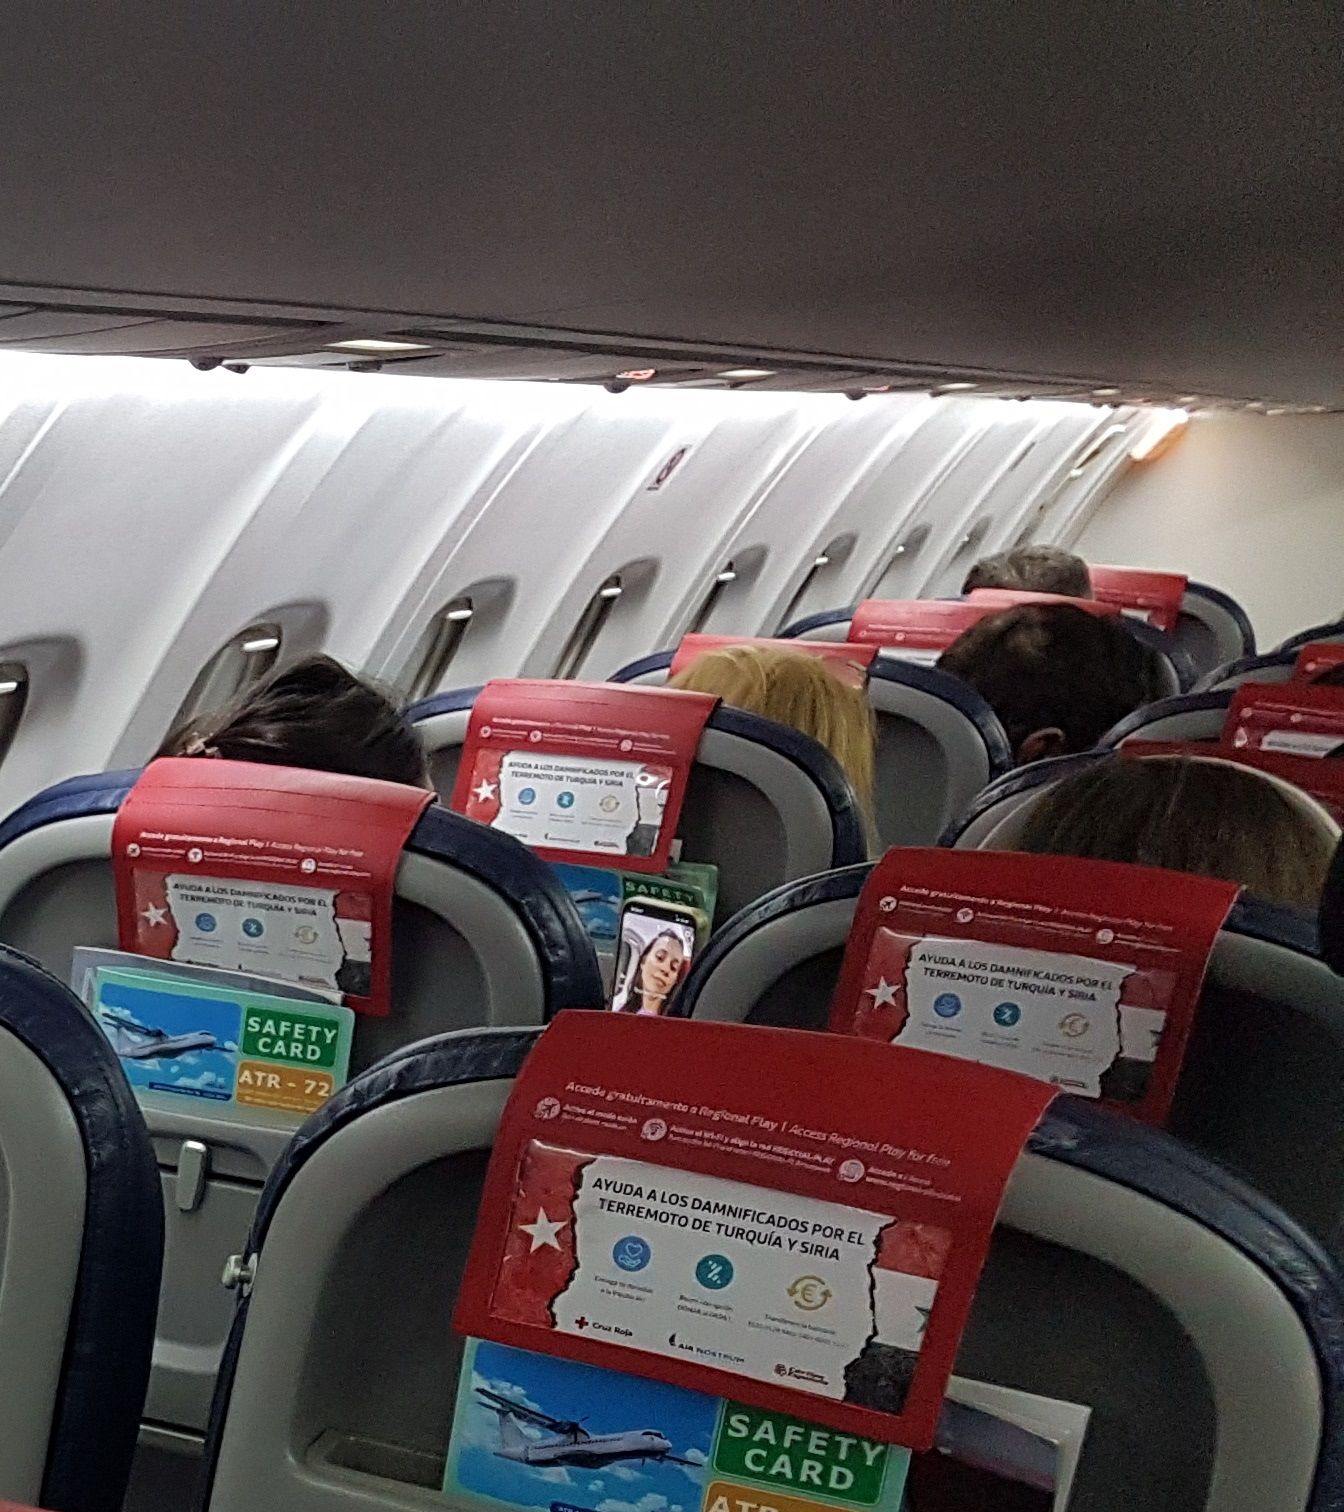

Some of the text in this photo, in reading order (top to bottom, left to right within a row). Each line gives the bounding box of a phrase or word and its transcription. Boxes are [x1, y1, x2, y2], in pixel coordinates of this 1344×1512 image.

[625, 881, 693, 901] SAFETY
[918, 952, 956, 966] AYUDA
[958, 959, 965, 967] A
[967, 960, 988, 971] LOS
[1075, 976, 1098, 988] POR
[247, 1016, 337, 1044] SAFETY
[258, 1037, 321, 1060] CARD
[238, 1069, 281, 1089] ATR
[304, 1080, 329, 1097] 72
[565, 1080, 606, 1097] Accede
[698, 1105, 749, 1127] Regional
[750, 1115, 778, 1132] Play
[788, 1123, 827, 1141] Access
[827, 1132, 879, 1154] Regional
[878, 1142, 906, 1160] Play
[907, 1149, 926, 1161] for
[592, 1176, 866, 1246] AYUDA A LOS DAMNIFICADOS POR EL
[598, 1197, 840, 1260] TERREMOTO DE TURQUÍA Y SIRIA
[591, 1321, 633, 1337] Cruz Roja
[727, 1414, 884, 1467] SAFETY
[744, 1448, 854, 1490] CARD
